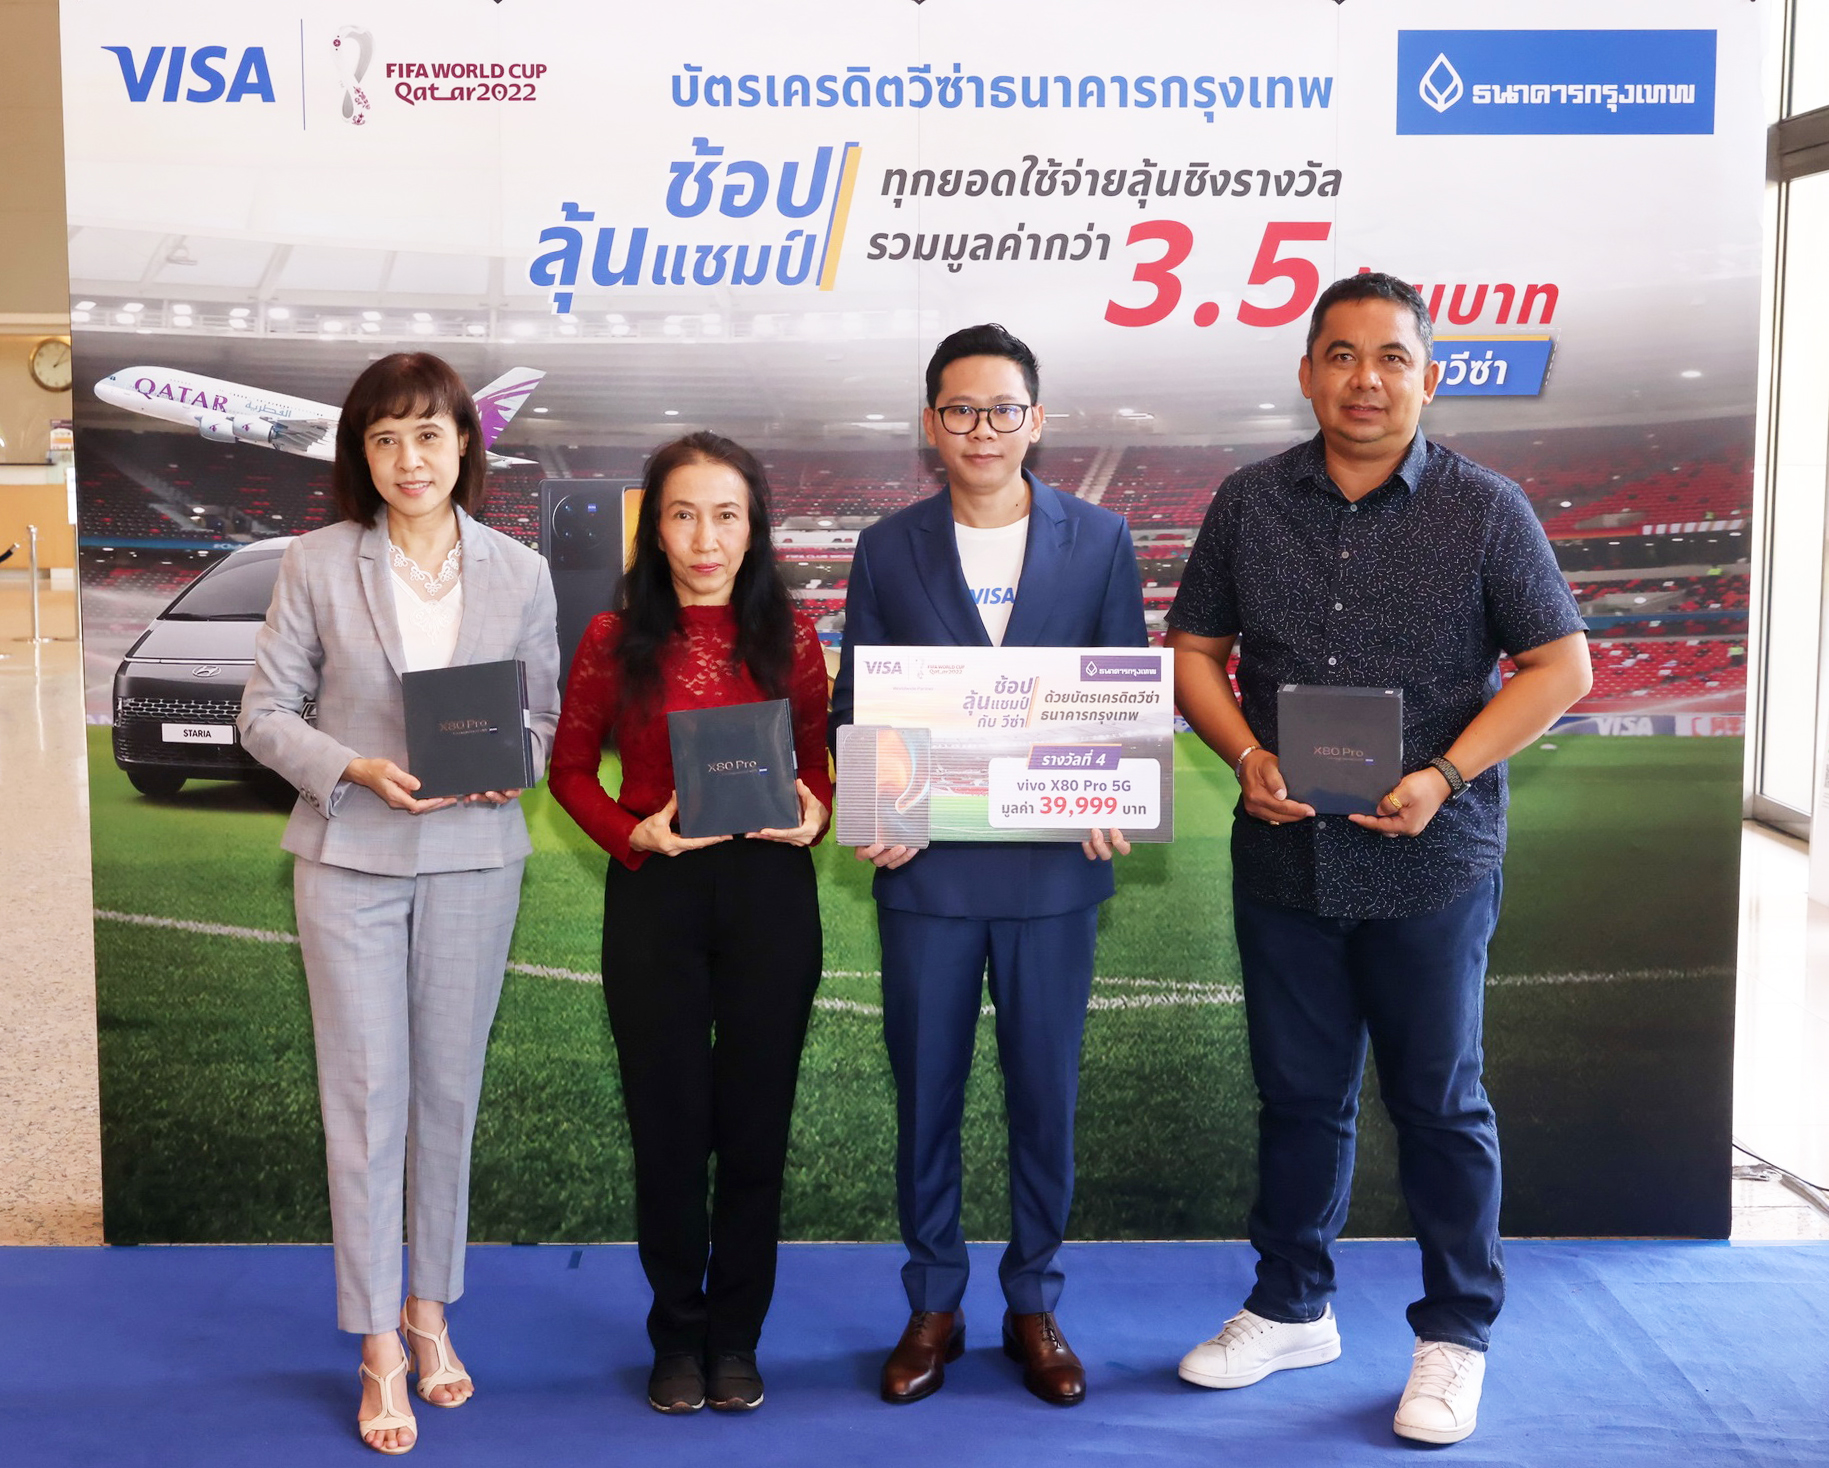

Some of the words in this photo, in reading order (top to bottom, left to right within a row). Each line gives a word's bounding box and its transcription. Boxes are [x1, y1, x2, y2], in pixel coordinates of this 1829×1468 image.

[102, 46, 276, 103] VISA
[386, 63, 429, 79] FIFA
[430, 63, 505, 79] WORLD
[508, 63, 548, 79] CUP
[671, 62, 1333, 123] บัตรเครดิตวีซ่าธนาคารกรุงเทพ
[1472, 83, 1696, 113] ธนาคารกรุงเทพ
[665, 137, 833, 218] ช้อป
[880, 154, 1342, 209] ทุกยอดใช้จ่ายลุ้นชิงรางวัล
[866, 223, 1111, 273] รวมมูลค่ากว่า
[1104, 219, 1332, 327] 3.5
[134, 378, 228, 413] QATAR
[969, 587, 1015, 604] VISA
[863, 660, 903, 675] VISA
[994, 675, 1033, 694] ช้อป
[1044, 690, 1160, 704] ด้วยบัตรเครดิตวีซ่า
[977, 714, 997, 728] กับ
[1001, 714, 1026, 728] วีซ่า
[1040, 710, 1139, 725] ธนาคารกรุงเทพ
[1596, 716, 1654, 736] VISA
[183, 728, 212, 738] STARIA
[1041, 749, 1093, 766] รางวัลที่
[1095, 753, 1107, 766] 4
[1313, 746, 1340, 756] X80
[1342, 747, 1364, 758] Pro
[707, 761, 734, 773] X80
[735, 760, 757, 770] Pro
[1016, 779, 1046, 792] vivo
[1050, 779, 1079, 792] X80
[1083, 779, 1108, 792] Pro
[1112, 779, 1131, 792] 5G
[1001, 800, 1035, 818] มูลค่า
[1039, 796, 1118, 818] 39,999
[1122, 804, 1147, 815] บาท
